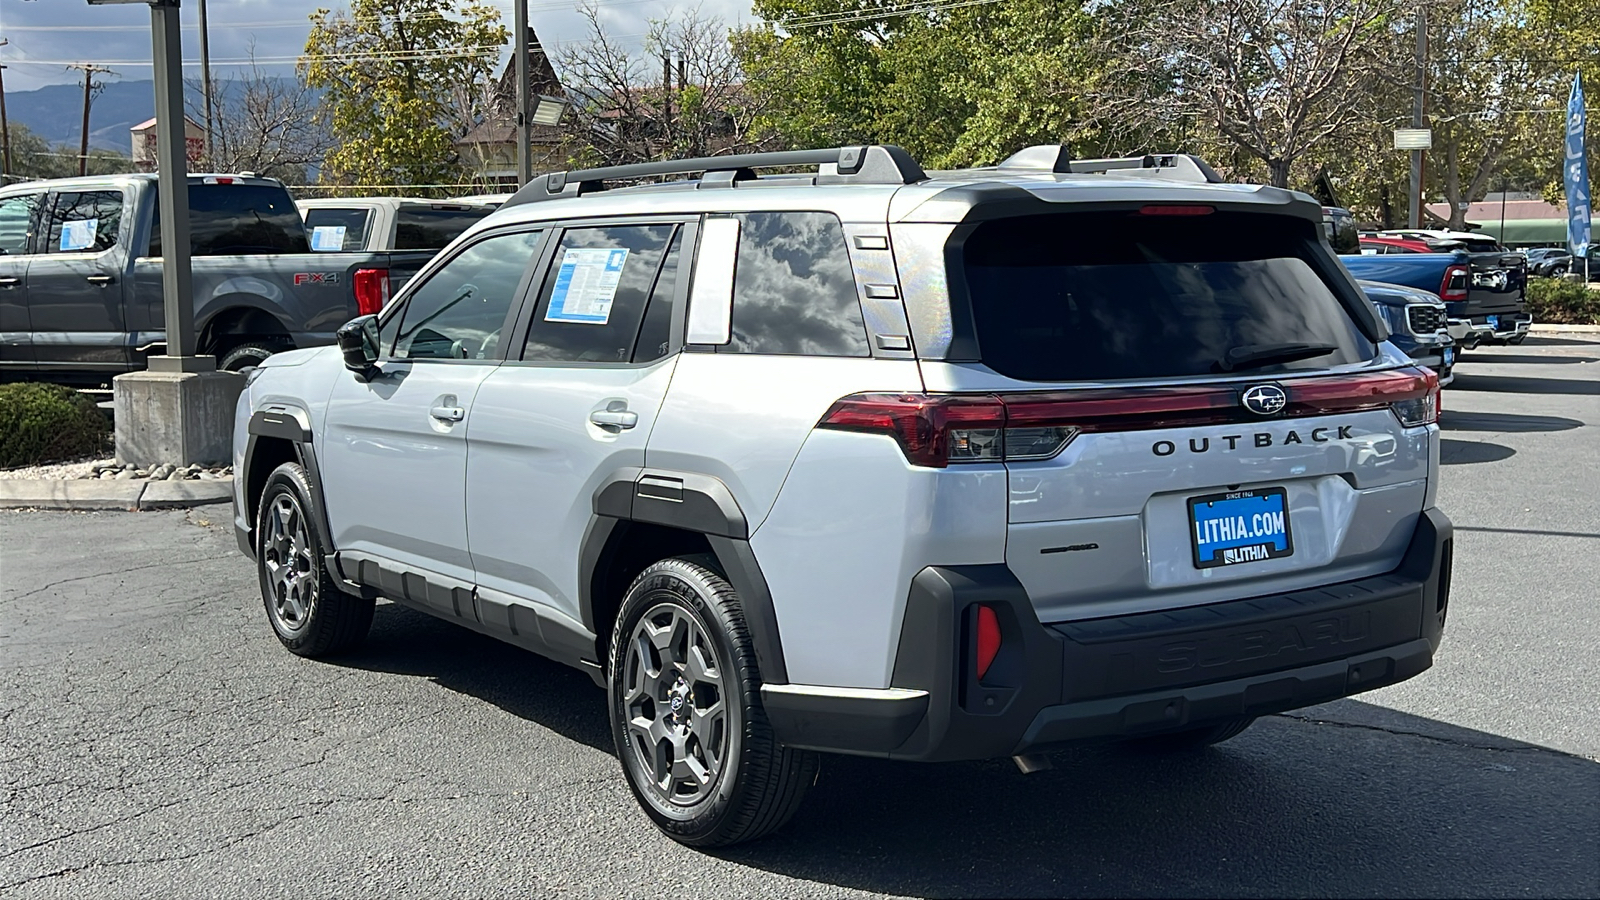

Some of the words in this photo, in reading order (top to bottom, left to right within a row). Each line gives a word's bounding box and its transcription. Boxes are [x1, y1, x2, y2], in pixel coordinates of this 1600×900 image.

[294, 272, 340, 286] FX4
[1152, 425, 1353, 456] OUTBACK
[1226, 492, 1241, 500] SINCE
[1196, 511, 1285, 544] LITHIA.COM
[1234, 544, 1269, 562] LITHIA
[1158, 610, 1371, 673] SUBARU
